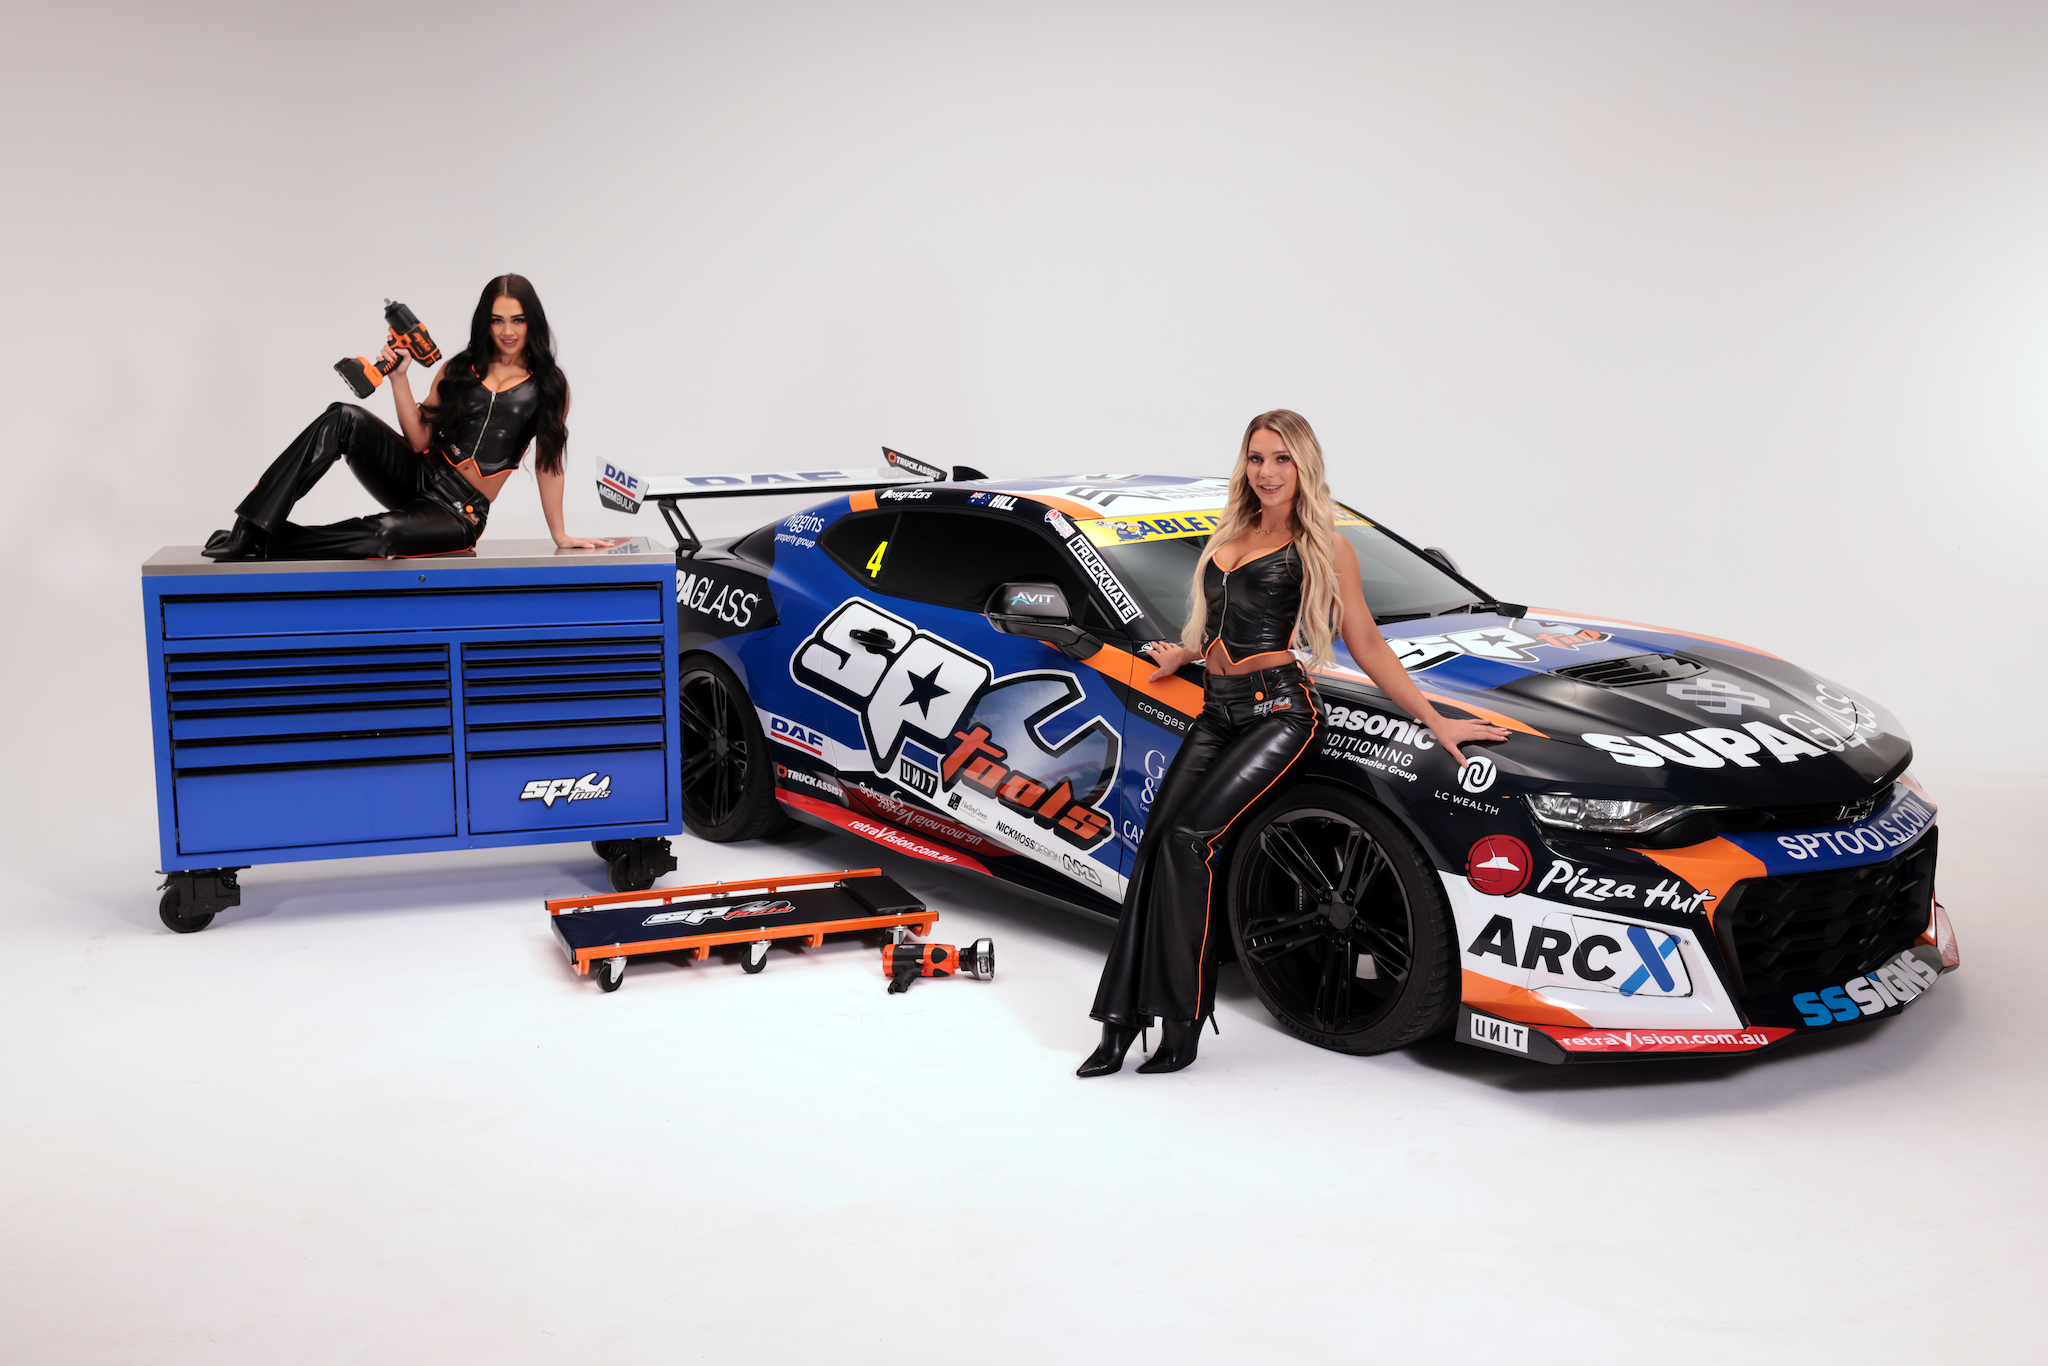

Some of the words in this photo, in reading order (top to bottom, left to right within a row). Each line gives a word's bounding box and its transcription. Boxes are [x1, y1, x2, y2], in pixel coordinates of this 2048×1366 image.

[604, 463, 638, 489] DAF
[683, 470, 850, 487] DAF
[599, 484, 635, 512] MGMBULK
[988, 494, 1019, 511] HILL
[783, 511, 826, 533] higgins
[1138, 515, 1210, 537] ABLE
[795, 537, 816, 549] group
[866, 541, 888, 578] 4
[1072, 536, 1137, 618] TRUCKMATE
[676, 569, 756, 627] PAGLASS
[1009, 591, 1055, 605] AVIT
[771, 716, 823, 747] DAF
[799, 602, 989, 761] SP
[942, 725, 1110, 841] tools
[1137, 701, 1185, 731] coregas
[1323, 702, 1438, 750] asonic
[1581, 683, 1878, 768] SUPAGLASS
[1144, 749, 1166, 780] G
[1326, 733, 1414, 767] DITIONING
[1330, 749, 1343, 760] by
[1342, 752, 1388, 771] Panasales
[1388, 765, 1418, 782] Group
[519, 778, 577, 808] SP
[567, 786, 612, 804] tools
[1434, 789, 1449, 802] LC
[1452, 795, 1500, 816] WEALTH
[847, 820, 958, 863] retraVision.com.au
[1776, 797, 1932, 860] SPTOOLS.COM
[1537, 859, 1636, 903] Pizza
[1643, 878, 1717, 914] Hut
[644, 906, 733, 924] SP
[1466, 913, 1682, 997] ARCX
[1561, 1031, 1769, 1048] retraVision.com.au
